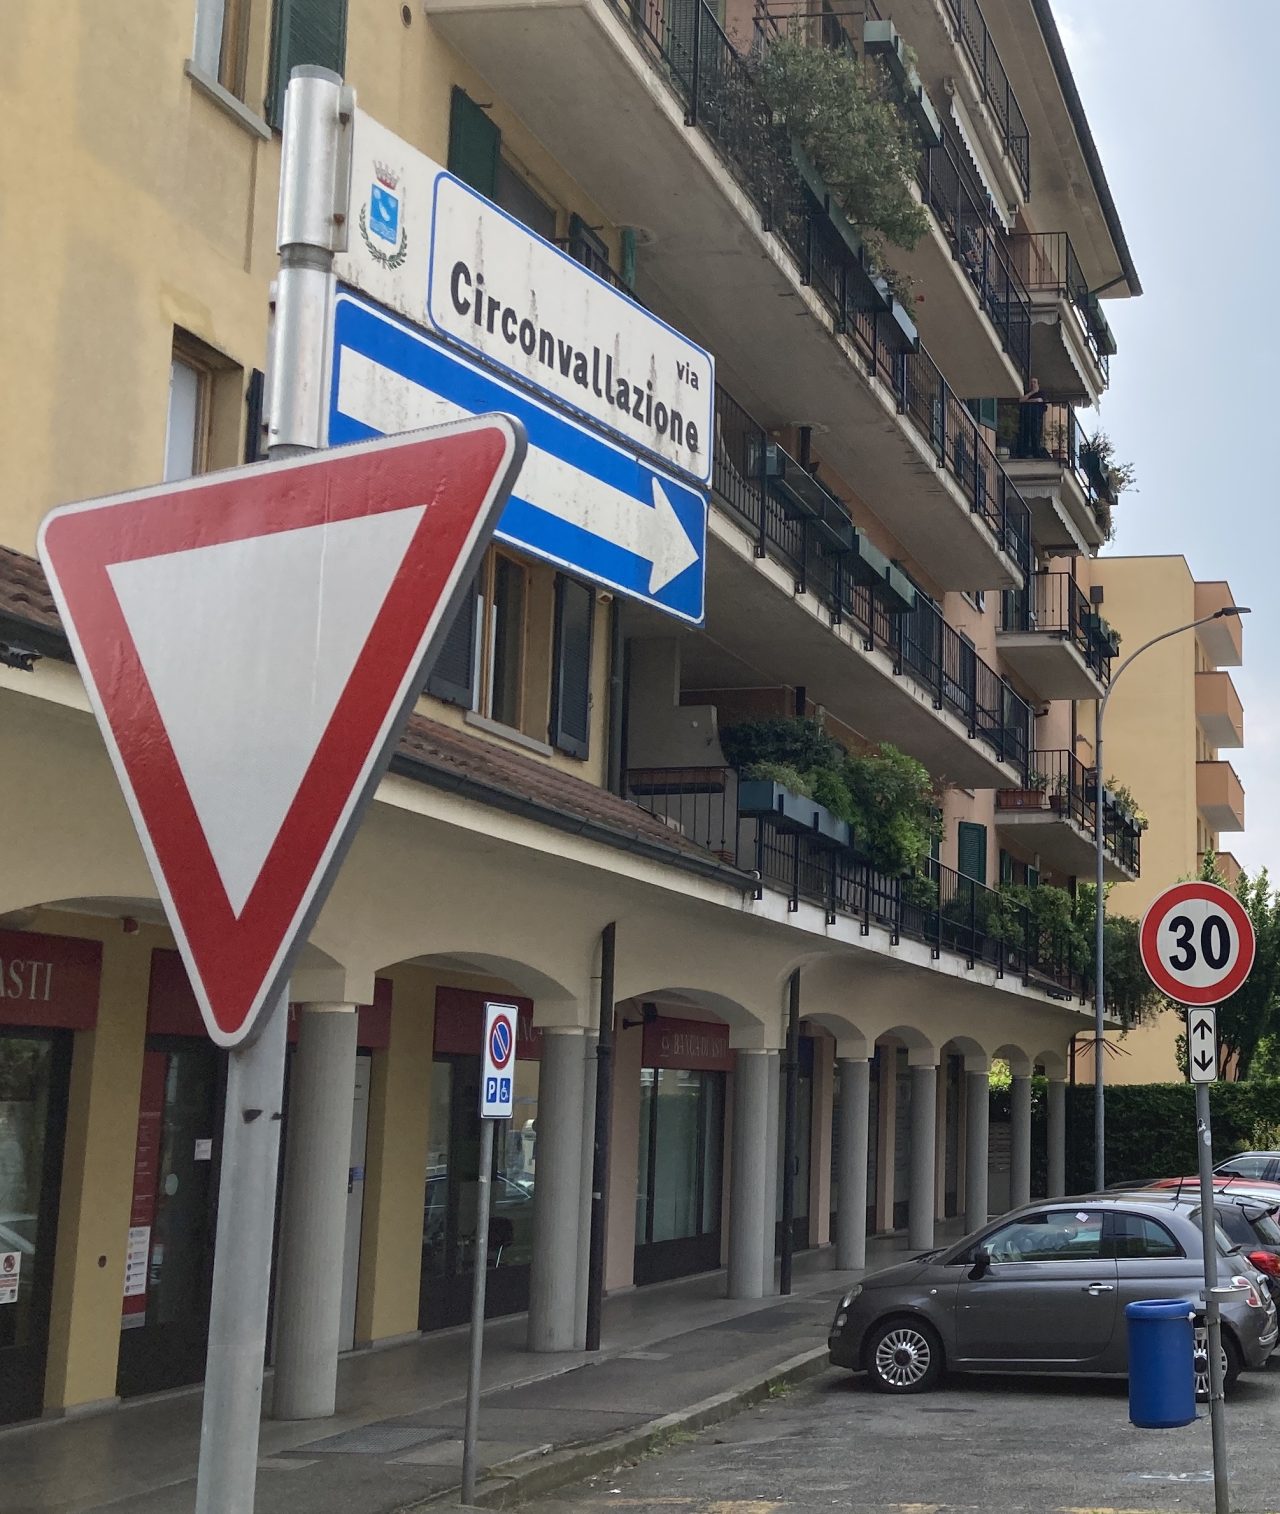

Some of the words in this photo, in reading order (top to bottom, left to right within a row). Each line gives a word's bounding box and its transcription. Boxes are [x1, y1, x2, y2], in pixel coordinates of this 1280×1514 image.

[450, 260, 699, 453] Circonvallazione
[676, 360, 699, 391] via
[1168, 914, 1231, 972] 30
[488, 1080, 496, 1100] P
